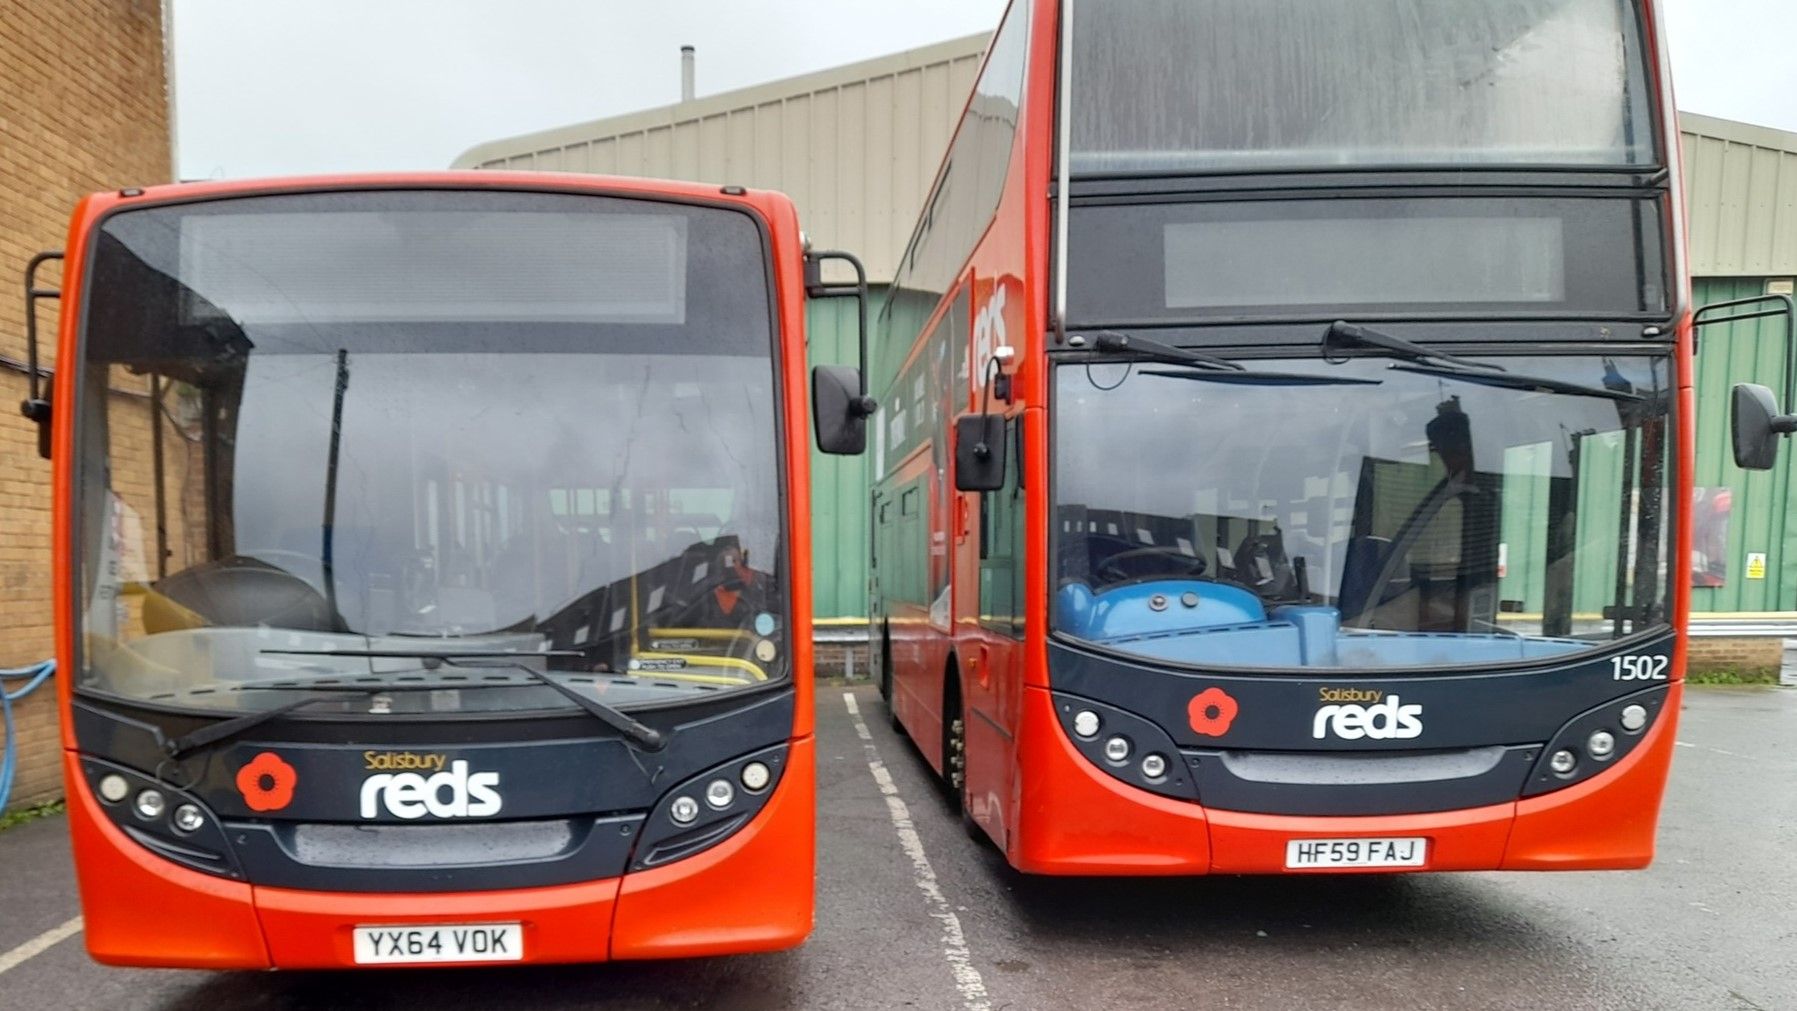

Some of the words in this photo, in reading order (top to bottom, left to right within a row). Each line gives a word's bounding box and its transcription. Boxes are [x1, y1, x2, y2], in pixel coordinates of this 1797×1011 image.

[1611, 655, 1668, 680] 1502
[1319, 687, 1383, 703] Salisbury
[1313, 695, 1423, 740] reds
[364, 751, 446, 771] Salisbury
[360, 760, 502, 819] reds
[1298, 842, 1360, 863] HF59
[1368, 841, 1415, 861] FAJ
[369, 931, 442, 956] YX64
[453, 929, 507, 953] VOK
